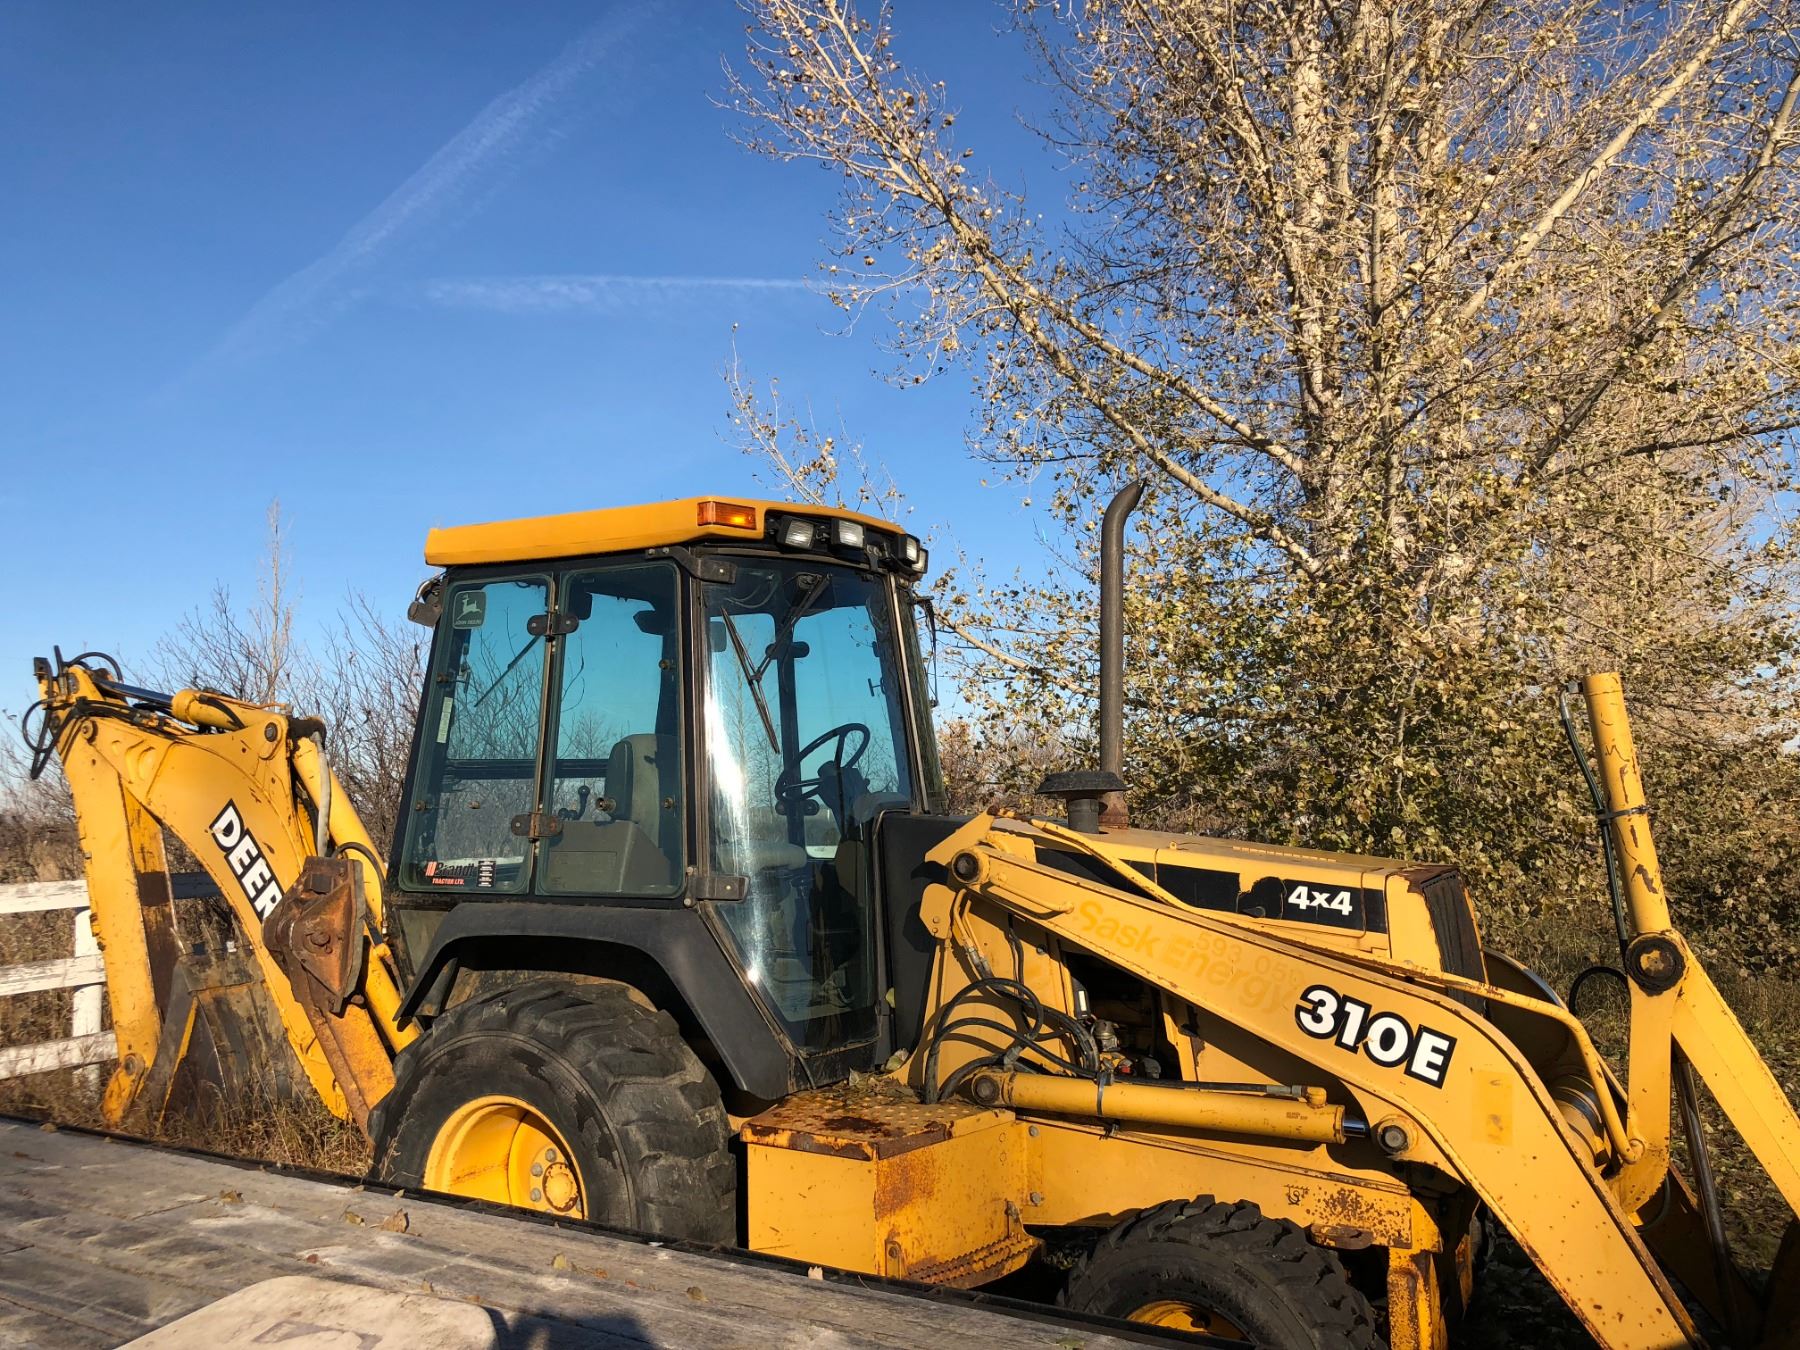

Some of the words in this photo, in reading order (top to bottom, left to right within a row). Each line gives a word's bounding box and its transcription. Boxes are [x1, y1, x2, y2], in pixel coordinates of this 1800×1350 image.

[1288, 885, 1353, 916] 4x4
[1080, 900, 1160, 959] Sask
[1163, 934, 1297, 1014] Energy
[1195, 932, 1243, 963] 593
[1296, 986, 1456, 1088] 310E
